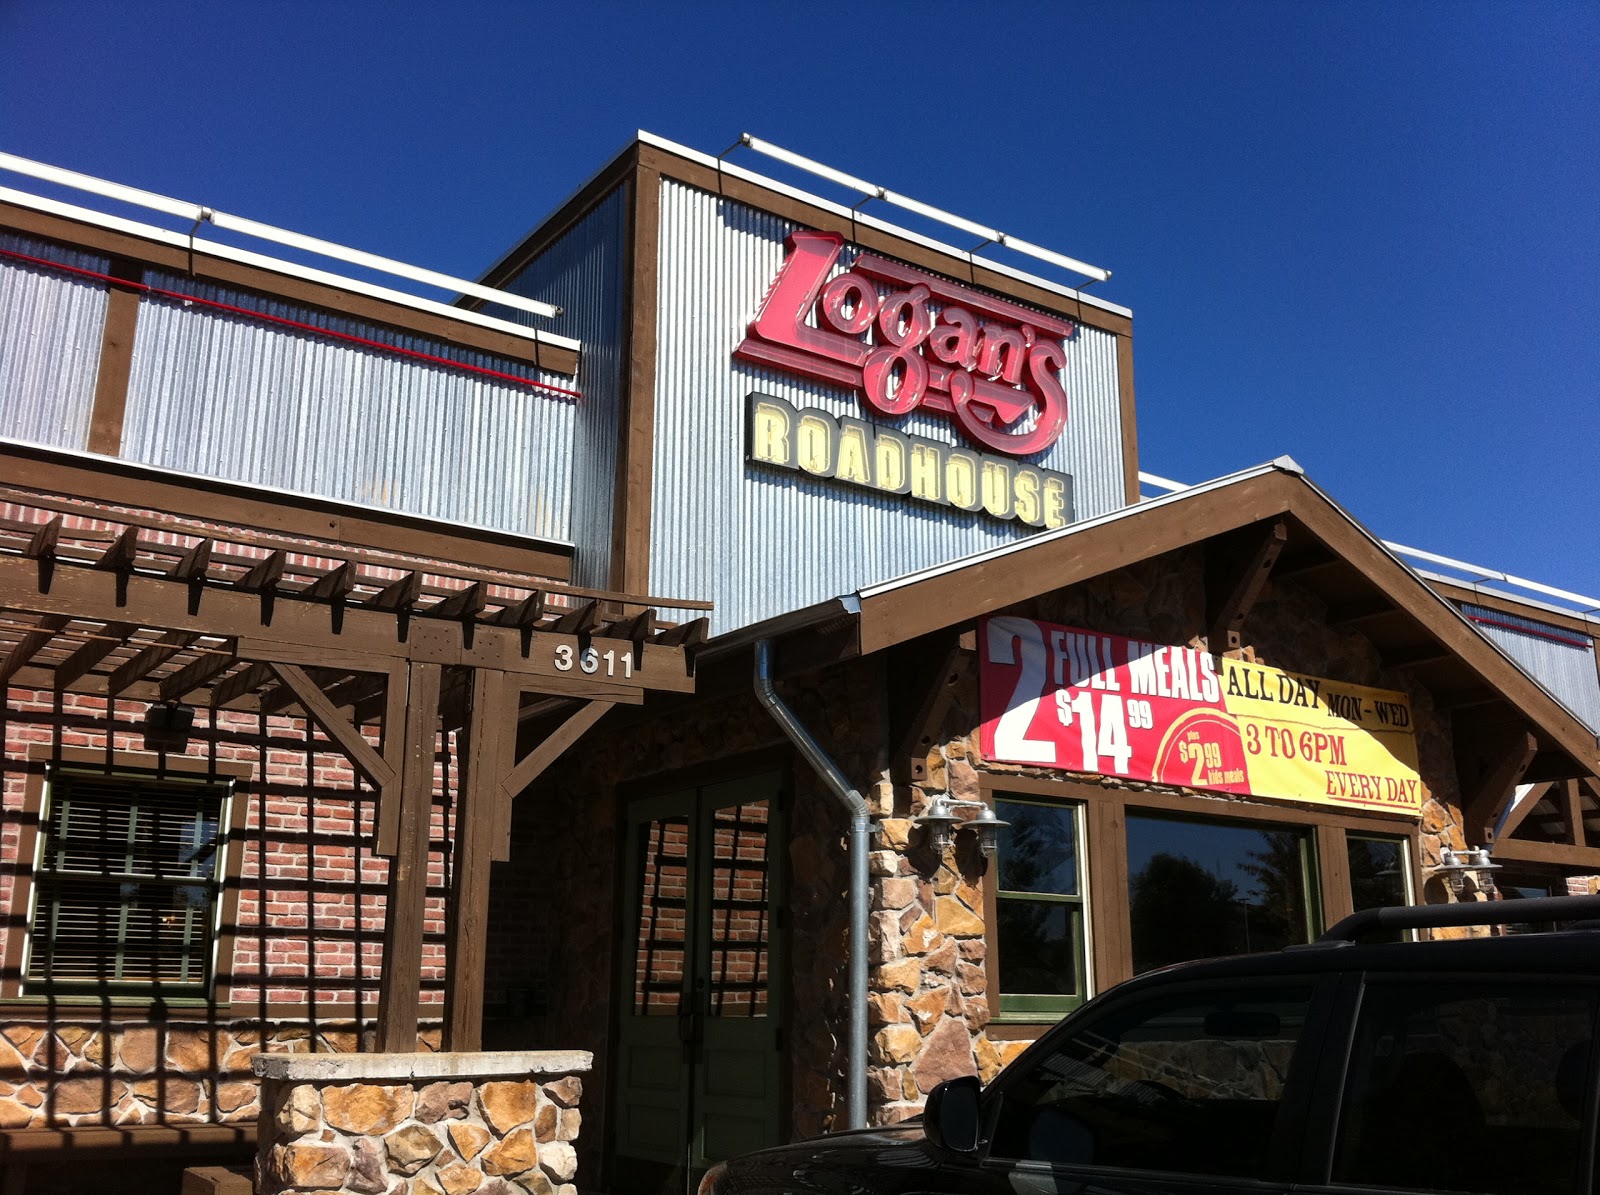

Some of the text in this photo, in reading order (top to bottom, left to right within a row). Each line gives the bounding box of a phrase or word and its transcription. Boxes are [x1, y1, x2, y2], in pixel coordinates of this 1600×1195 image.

[736, 231, 1068, 455] Logan's
[752, 402, 1066, 529] ROADHOUSE
[554, 644, 632, 679] 3611
[986, 616, 1220, 763] 2 FULL MEALS
[1227, 666, 1320, 709] ALL DAY
[1376, 701, 1409, 727] WED
[1246, 724, 1347, 766] 3 TO 6PM
[1208, 768, 1244, 785] kids meals
[1325, 770, 1417, 804] EVERY DAY
